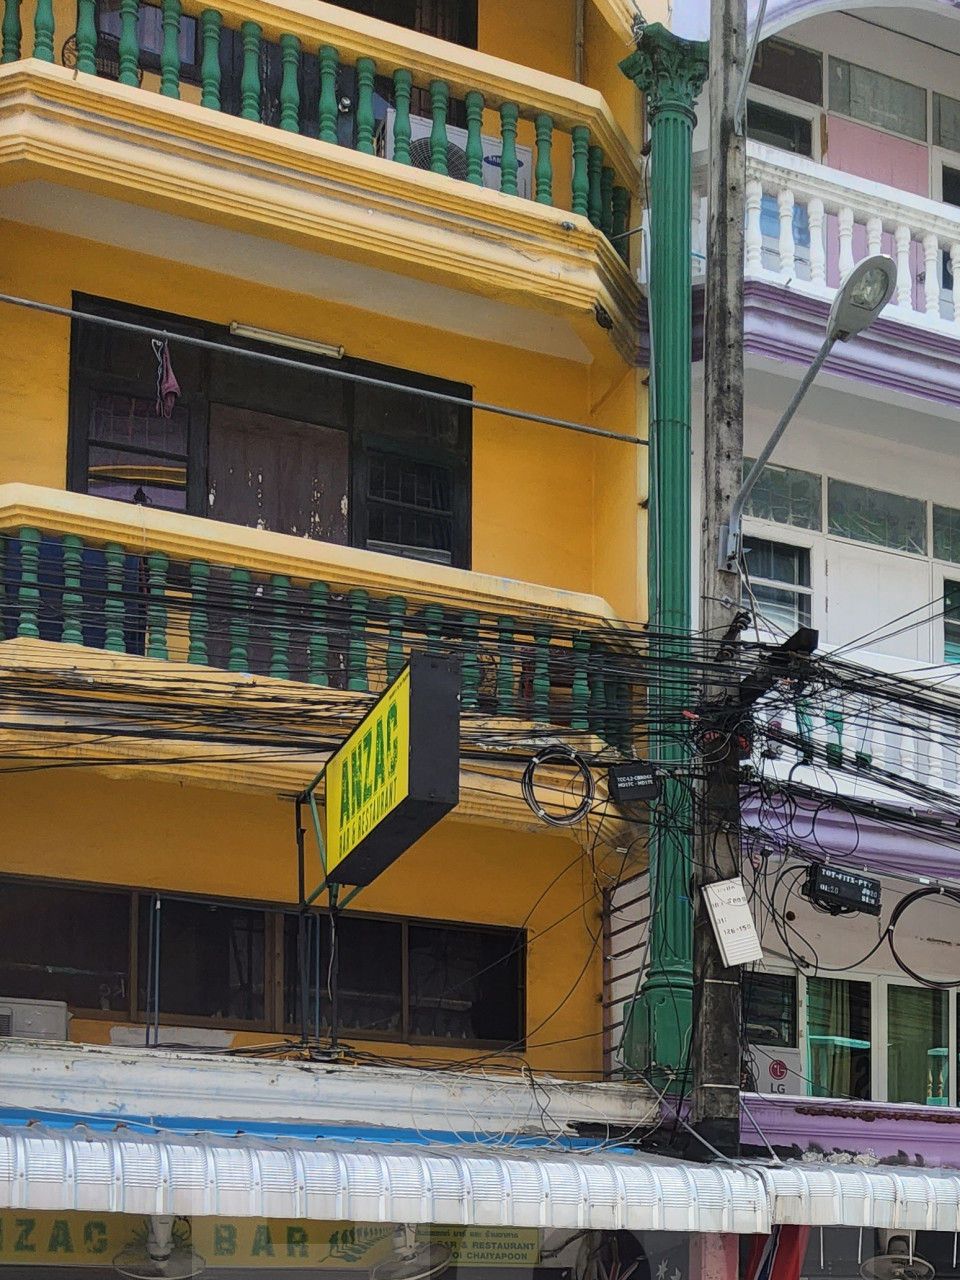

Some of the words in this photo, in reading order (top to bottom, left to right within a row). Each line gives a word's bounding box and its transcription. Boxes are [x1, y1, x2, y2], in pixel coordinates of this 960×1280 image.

[340, 701, 399, 832] ANZAC
[770, 1083, 786, 1094] LG
[0, 1218, 109, 1254] ZAC
[213, 1223, 310, 1260] BAR
[472, 1241, 536, 1250] RESTAURANT
